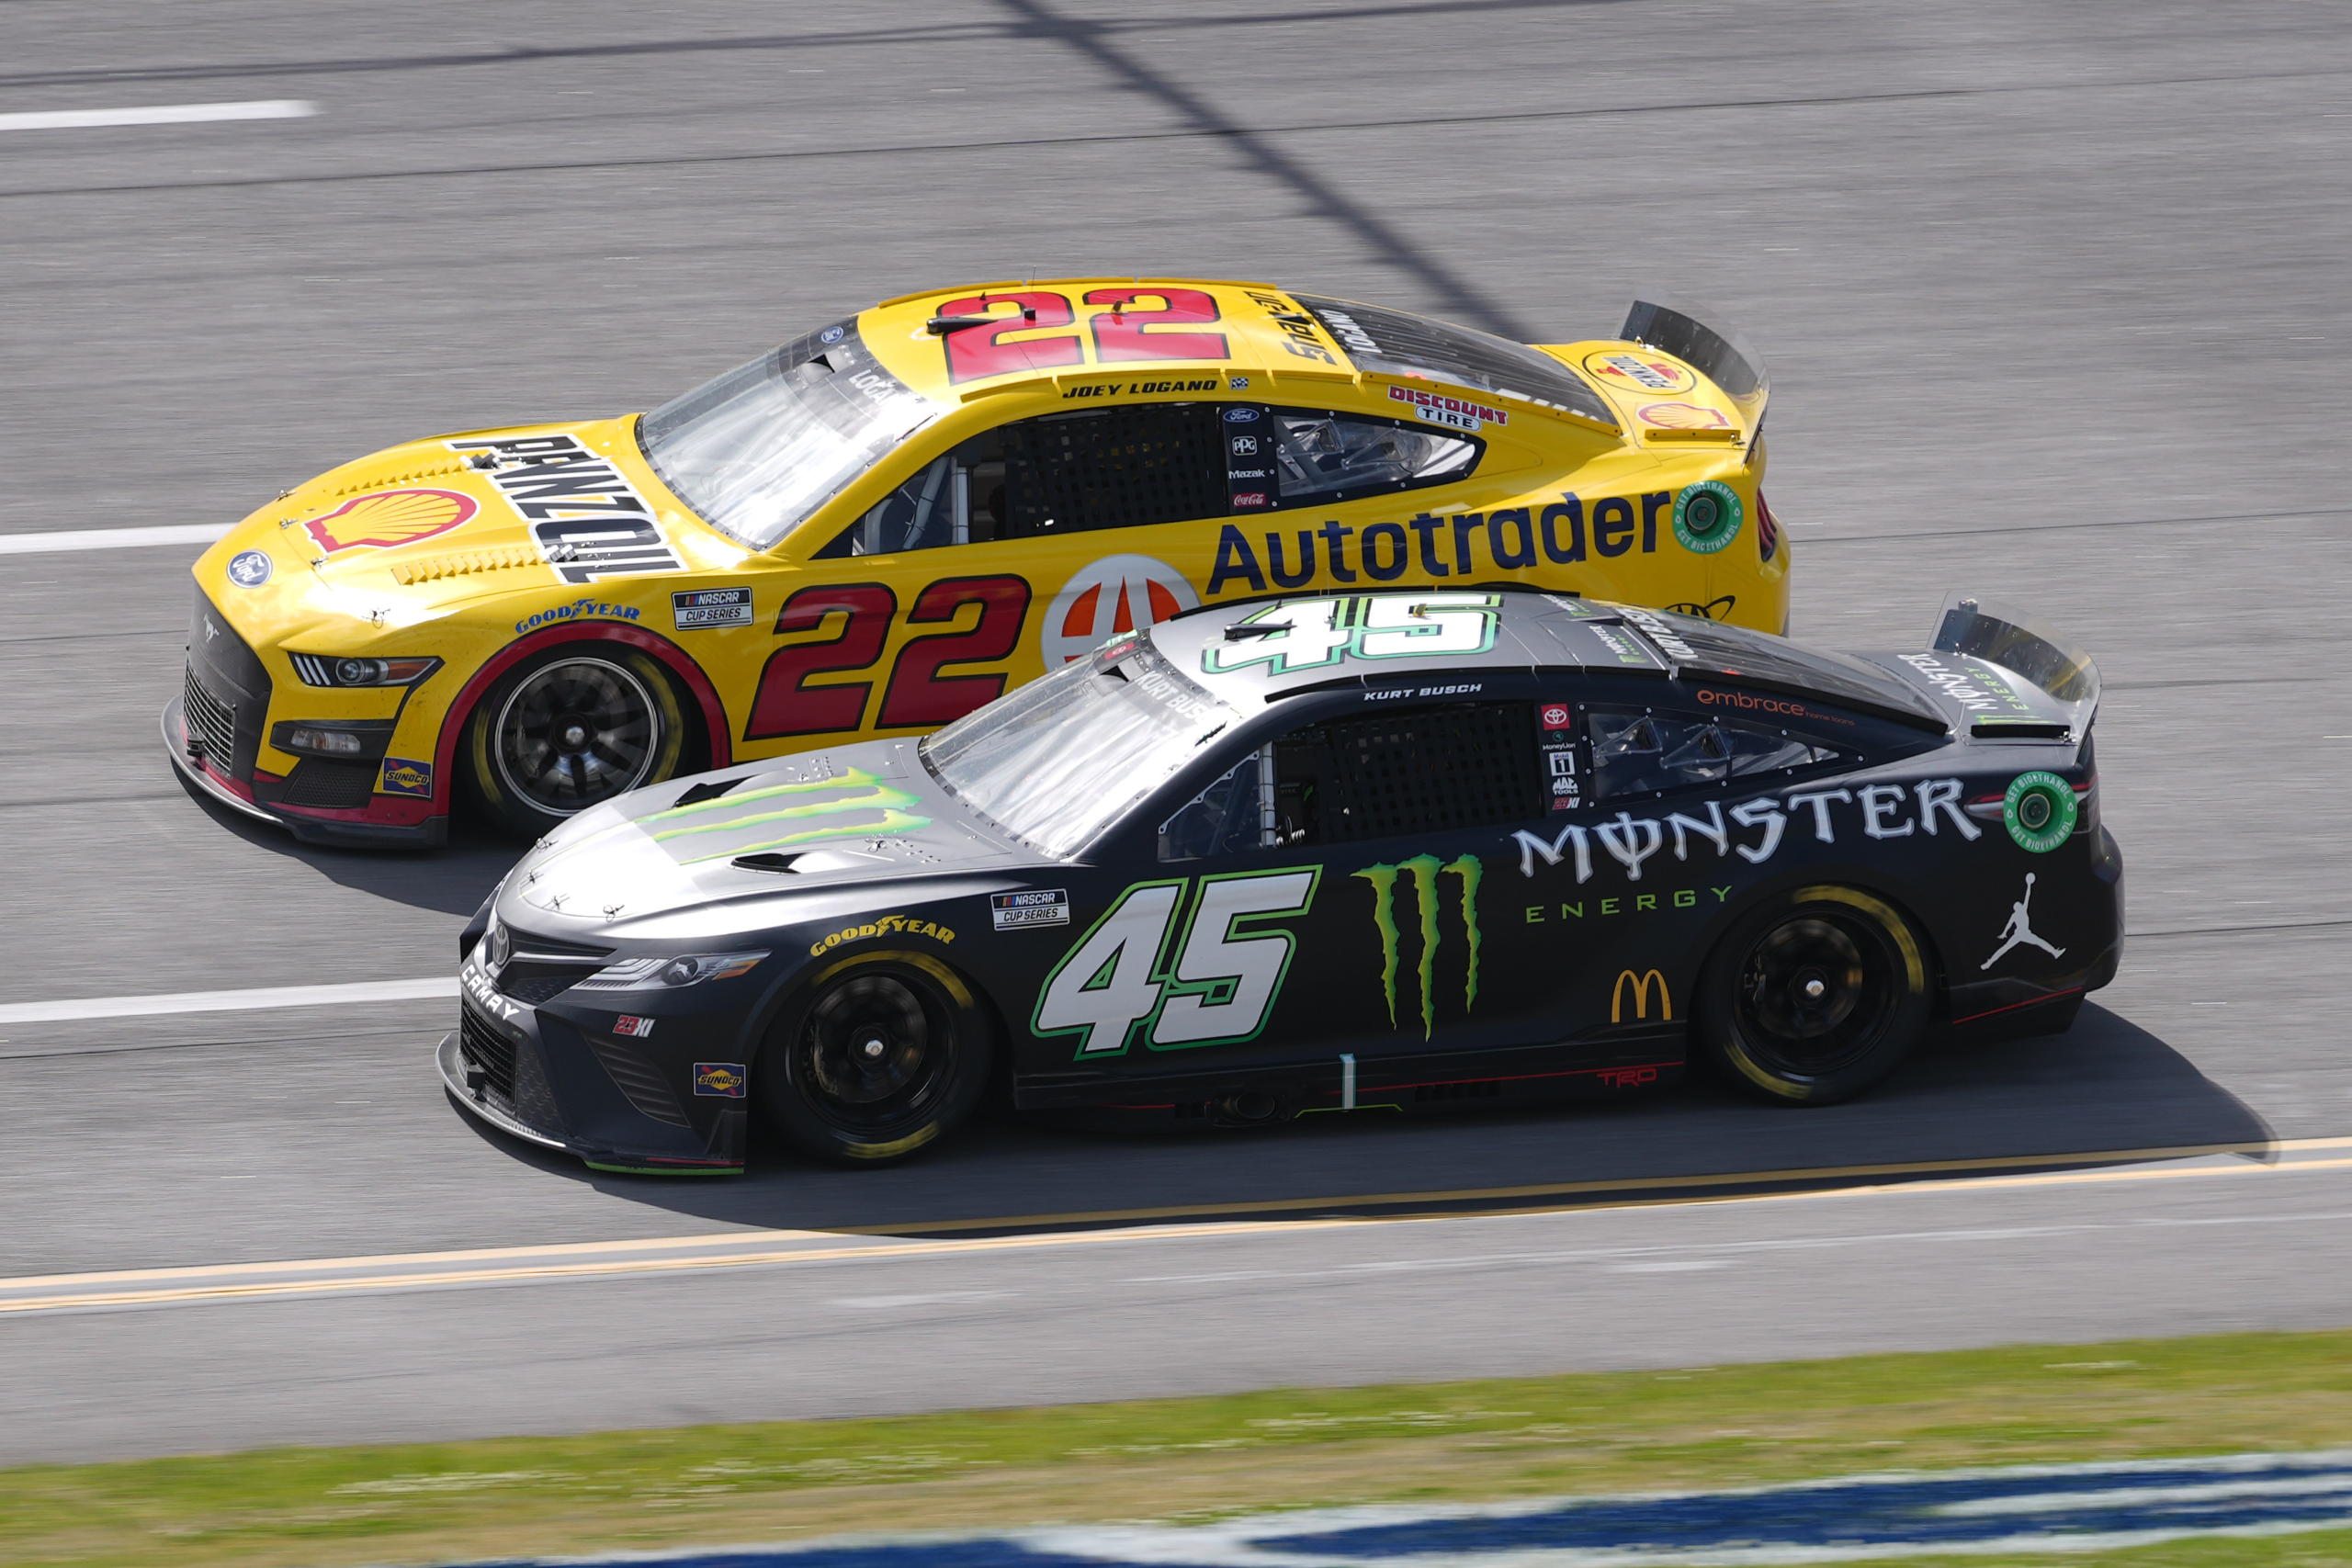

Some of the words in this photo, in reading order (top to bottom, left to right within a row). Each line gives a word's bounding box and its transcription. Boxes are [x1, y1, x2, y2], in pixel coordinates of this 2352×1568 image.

[935, 288, 1231, 387] 22
[1062, 381, 1123, 400] JOEY
[1128, 378, 1218, 394] LOGANO
[1389, 385, 1508, 425] DISCOUNT
[1421, 408, 1474, 429] TIRE
[1228, 468, 1266, 479] Mazak
[444, 434, 688, 584] PENNZOIL
[1205, 491, 1672, 596] Autotrader
[698, 592, 740, 605] NASCAR
[685, 610, 707, 622] CUP
[707, 607, 742, 620] SERIES
[1201, 592, 1505, 678] 45
[742, 572, 1033, 741] 22
[1136, 671, 1180, 701] KURT
[1363, 688, 1415, 702] KURT
[1419, 682, 1483, 697] BUSCH
[1896, 652, 1999, 711] MONSTER
[1963, 666, 2030, 712] ENERGY
[1697, 690, 1805, 716] embrace
[1805, 711, 1830, 721] home
[1831, 716, 1856, 727] loans
[1543, 741, 1577, 751] MoneyLion
[387, 772, 429, 784] SUNOCO
[1558, 760, 1566, 773] 1
[1553, 777, 1578, 791] MAC
[2007, 785, 2019, 803] GET
[2018, 773, 2071, 798] BIOETHANOL
[1510, 777, 1983, 884] MONSTER
[2012, 825, 2025, 842] GET
[2026, 820, 2073, 851] BIOETHANOL
[1014, 892, 1056, 907] NASCAR
[1525, 885, 1733, 924] ENERGY
[1003, 909, 1023, 923] CUP
[1023, 907, 1059, 921] SERIES
[1030, 863, 1324, 1062] 45
[699, 1076, 742, 1088] SUNOCO
[1596, 1067, 1657, 1089] TRD
